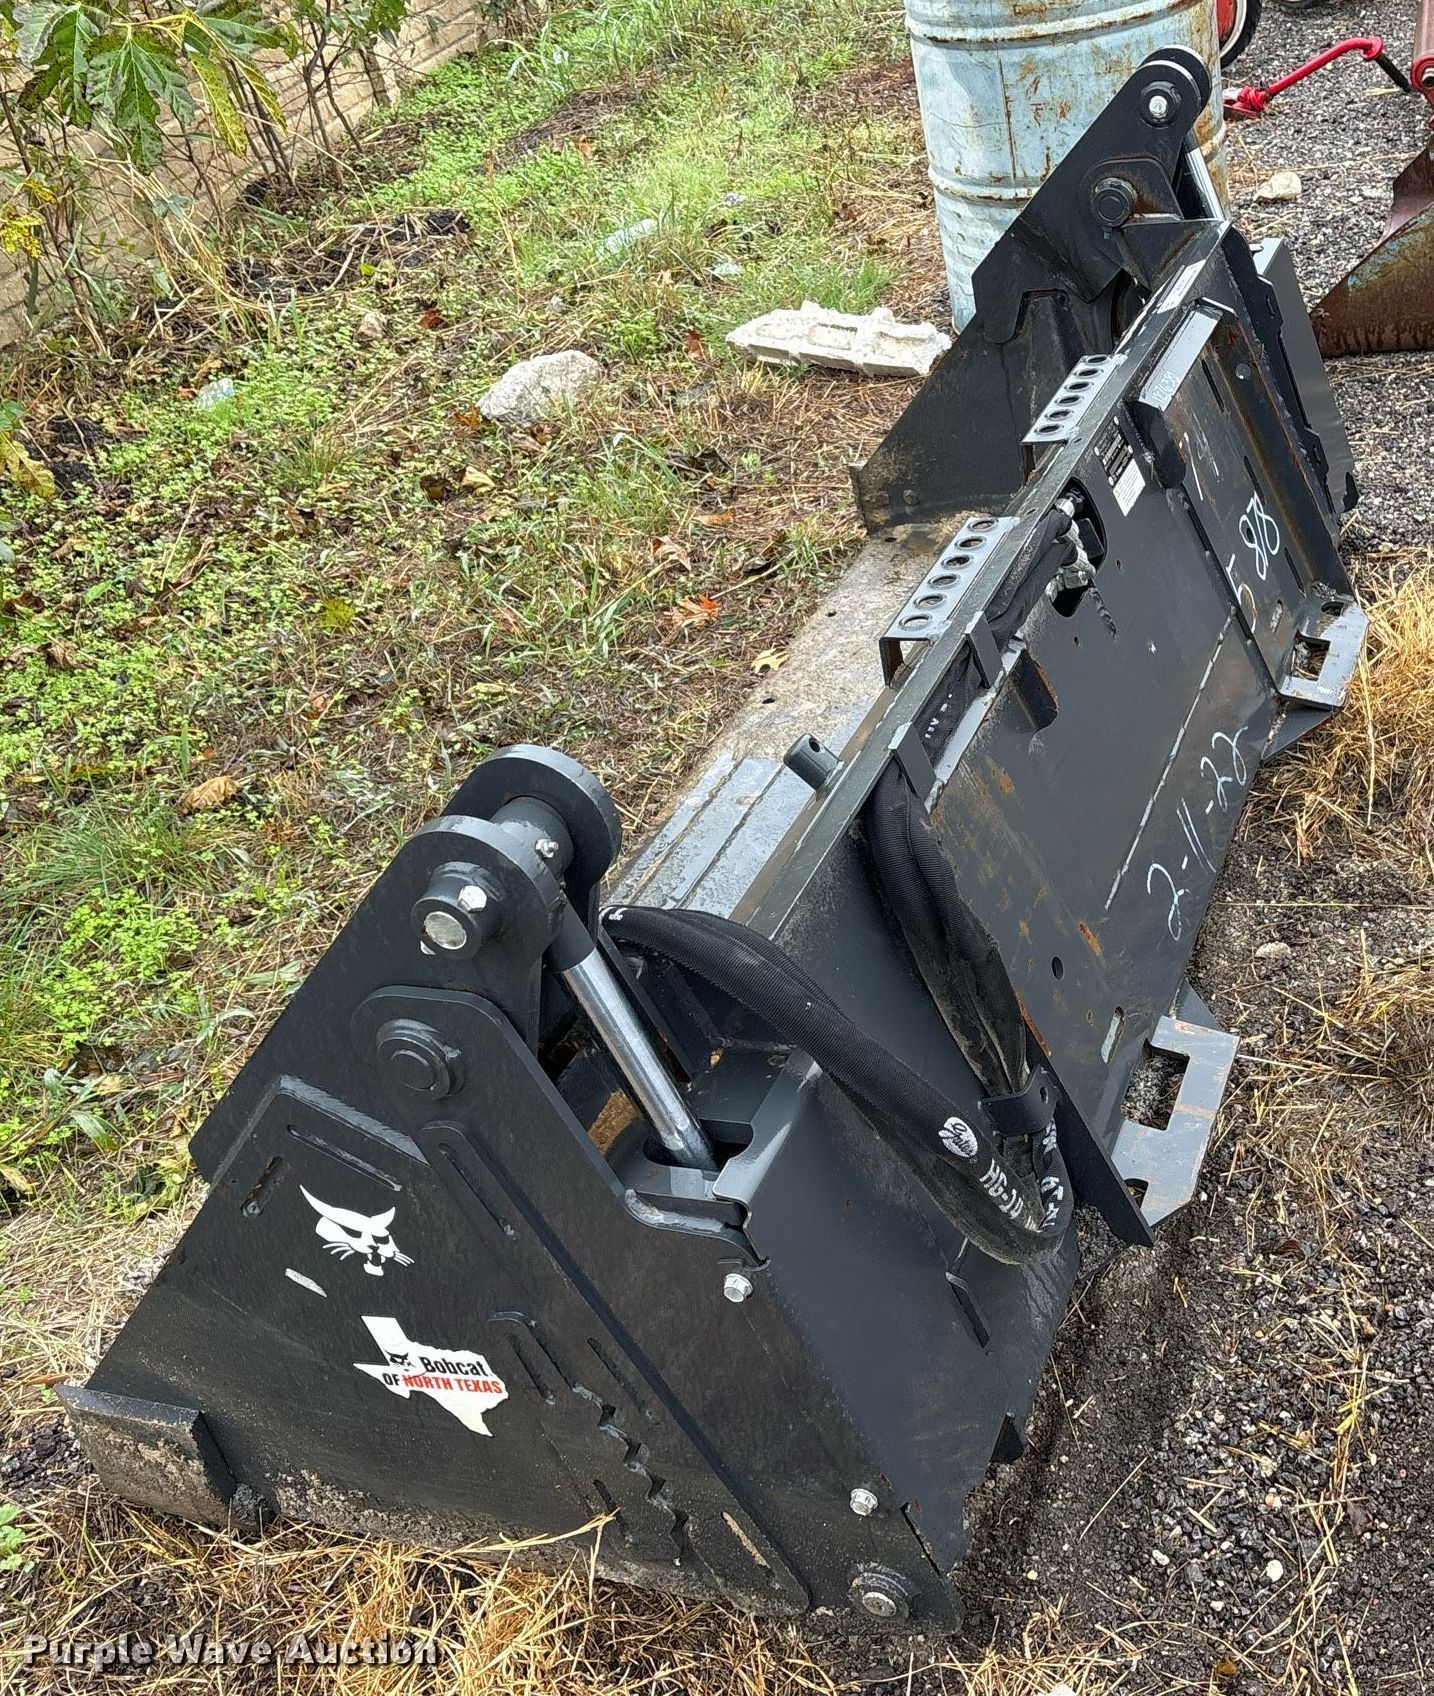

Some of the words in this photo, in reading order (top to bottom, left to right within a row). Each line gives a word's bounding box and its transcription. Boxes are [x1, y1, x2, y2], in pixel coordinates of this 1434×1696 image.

[1146, 725, 1249, 942] 2-11-22
[419, 1356, 489, 1377] Bobcat
[382, 1372, 401, 1386] OF
[402, 1374, 453, 1390] NORTH
[456, 1377, 503, 1395] TEXAS
